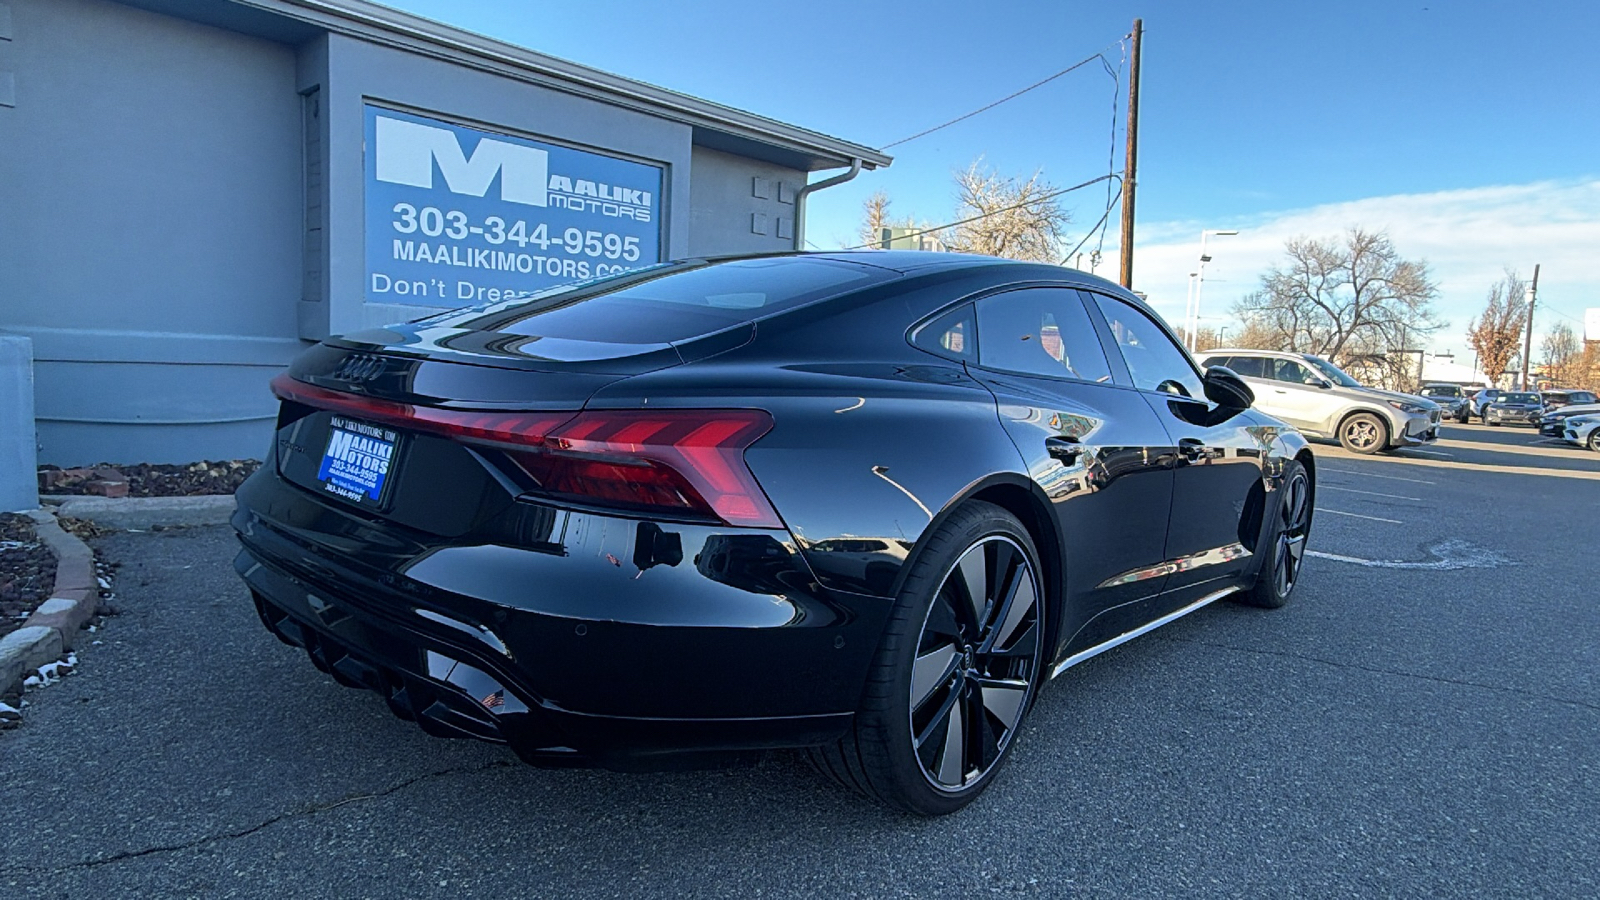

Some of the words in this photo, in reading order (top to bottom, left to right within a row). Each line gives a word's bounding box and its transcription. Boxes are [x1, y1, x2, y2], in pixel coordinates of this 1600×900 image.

[549, 193, 651, 223] MOTORS
[392, 202, 640, 262] 303-344-9595
[393, 239, 629, 279] MAALIKIMOTORS.C
[372, 273, 446, 298] Don't
[331, 459, 378, 482] 303-344-9595
